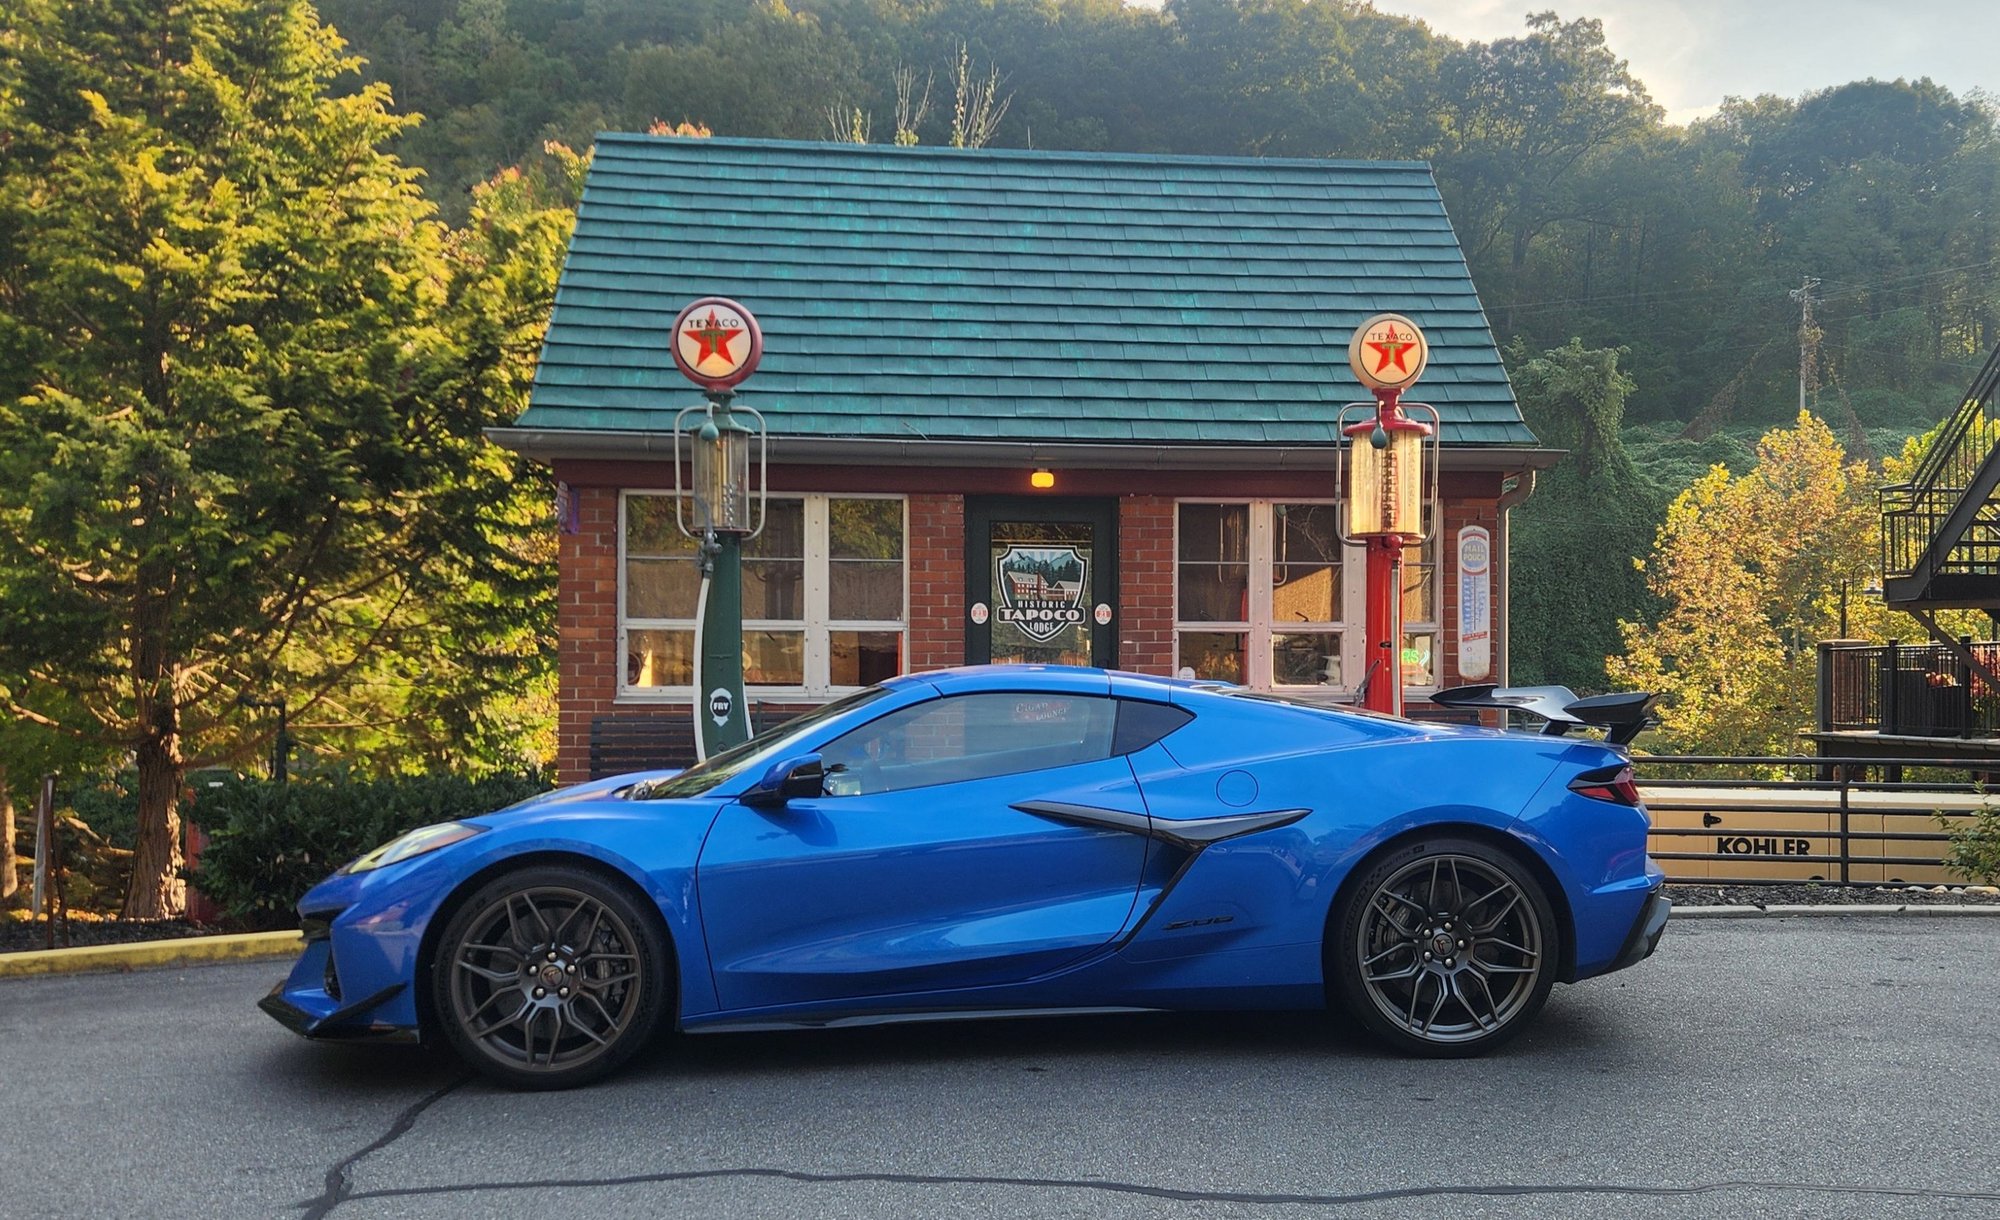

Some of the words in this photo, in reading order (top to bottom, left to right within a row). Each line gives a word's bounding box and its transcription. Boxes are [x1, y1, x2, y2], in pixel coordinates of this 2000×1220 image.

[688, 319, 739, 328] TEXACO
[1370, 332, 1413, 341] TEXACO
[1464, 544, 1485, 552] MAIL
[1463, 553, 1486, 561] POUCH
[1018, 601, 1066, 609] HISTORIC
[1001, 609, 1080, 621] TAPOCO
[1029, 621, 1054, 632] LODGE
[713, 702, 729, 710] FRY
[1717, 837, 1810, 855] KOHLER
